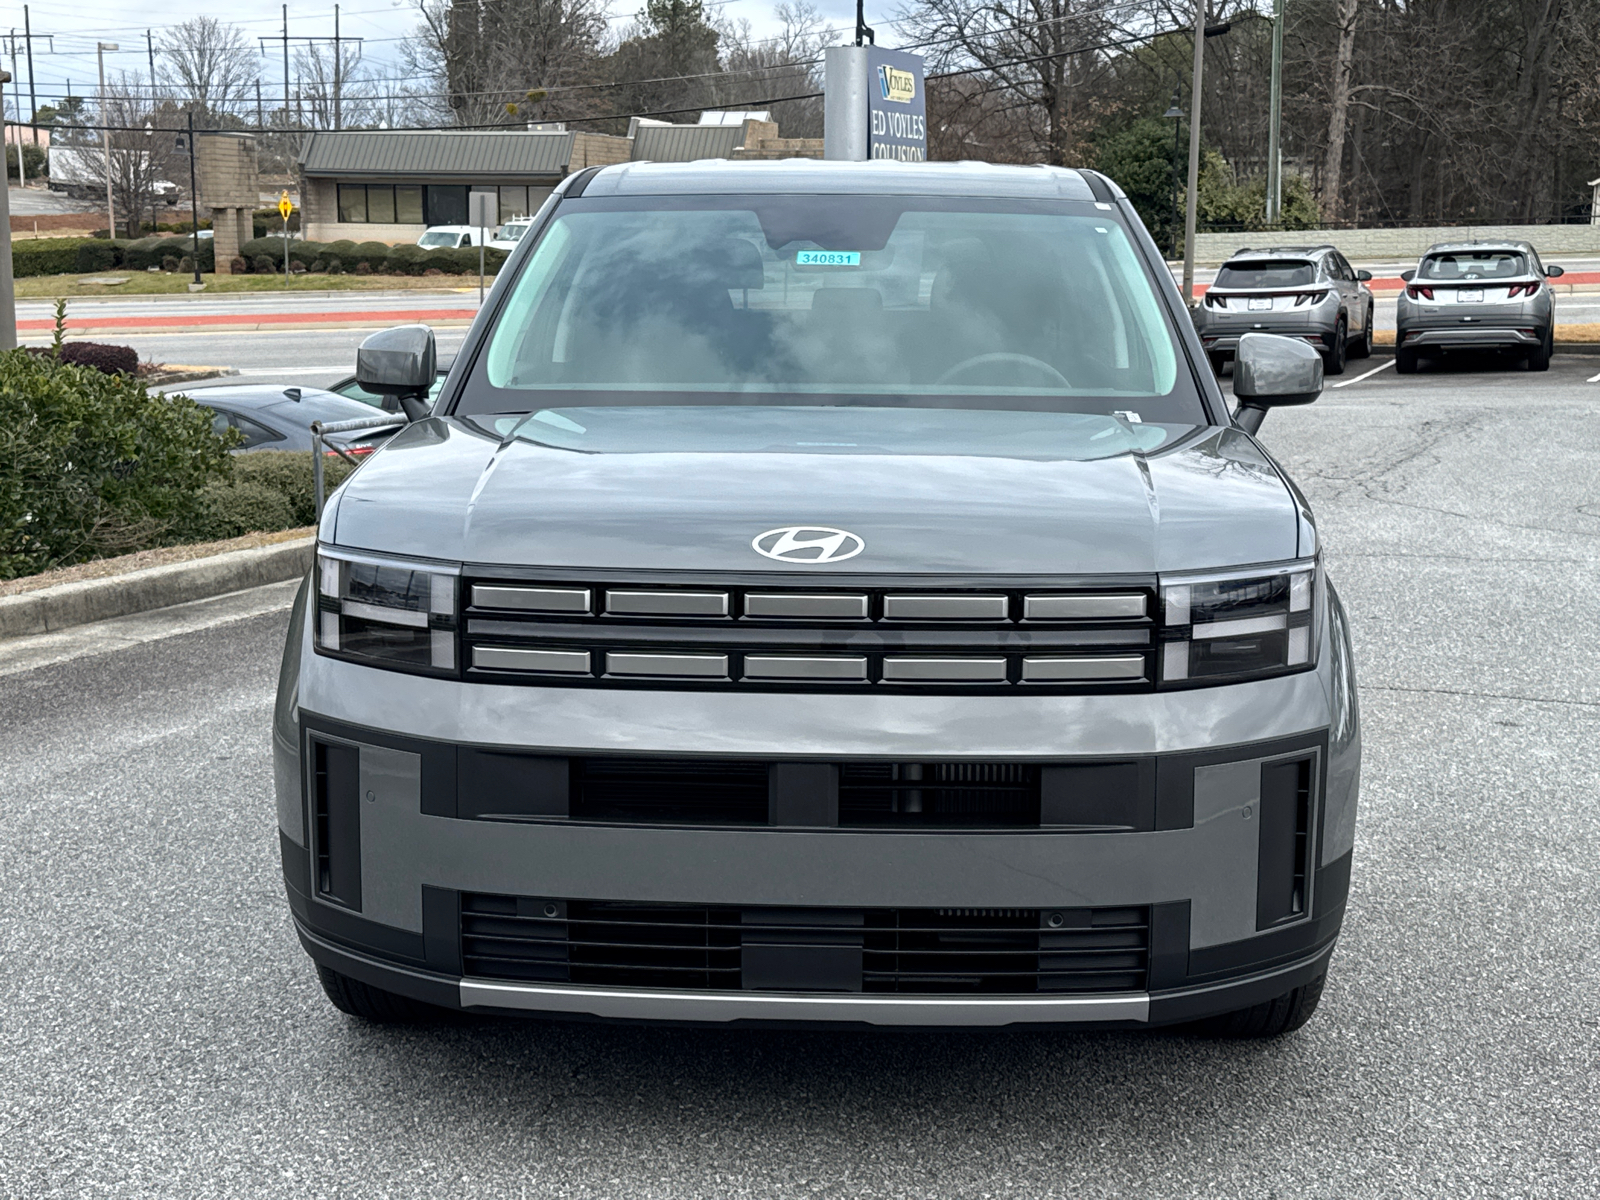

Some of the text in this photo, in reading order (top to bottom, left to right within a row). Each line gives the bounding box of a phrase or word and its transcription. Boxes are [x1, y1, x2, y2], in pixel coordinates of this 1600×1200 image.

[882, 65, 913, 96] VOYLES
[872, 110, 924, 140] ED VOYLES
[802, 253, 851, 264] 340831
